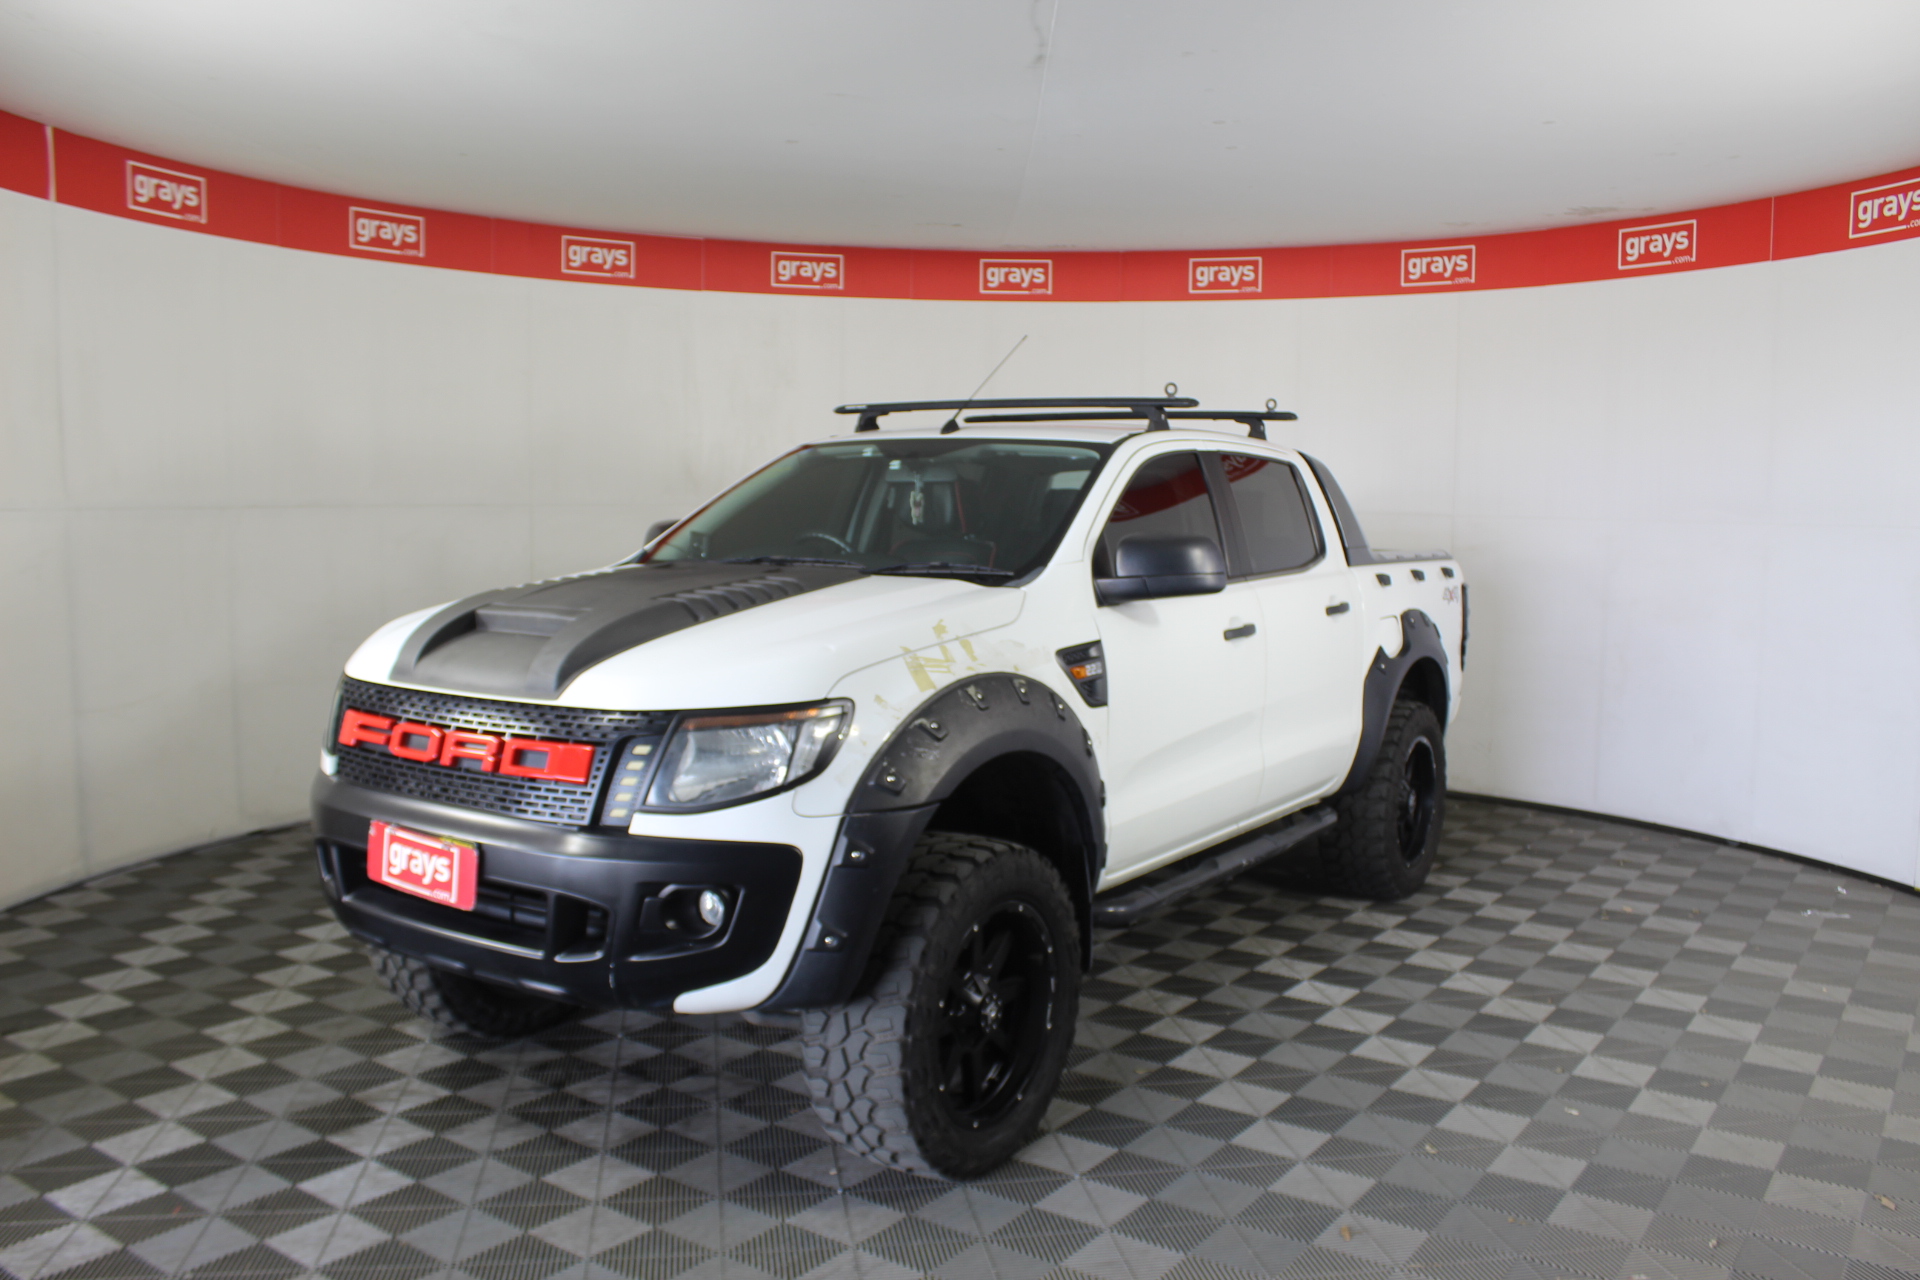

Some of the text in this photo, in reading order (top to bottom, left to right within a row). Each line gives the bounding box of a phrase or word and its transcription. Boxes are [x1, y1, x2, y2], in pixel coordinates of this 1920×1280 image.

[134, 173, 200, 210] grays
[1857, 189, 1920, 228] grays
[356, 217, 418, 247] grays
[1625, 229, 1690, 262] grays
[568, 243, 628, 270] grays
[1407, 254, 1468, 280] grays
[1672, 253, 1691, 265] .com
[777, 259, 837, 282] grays
[986, 264, 1046, 288] grays
[1195, 264, 1255, 287] grays
[389, 842, 451, 885] grays
